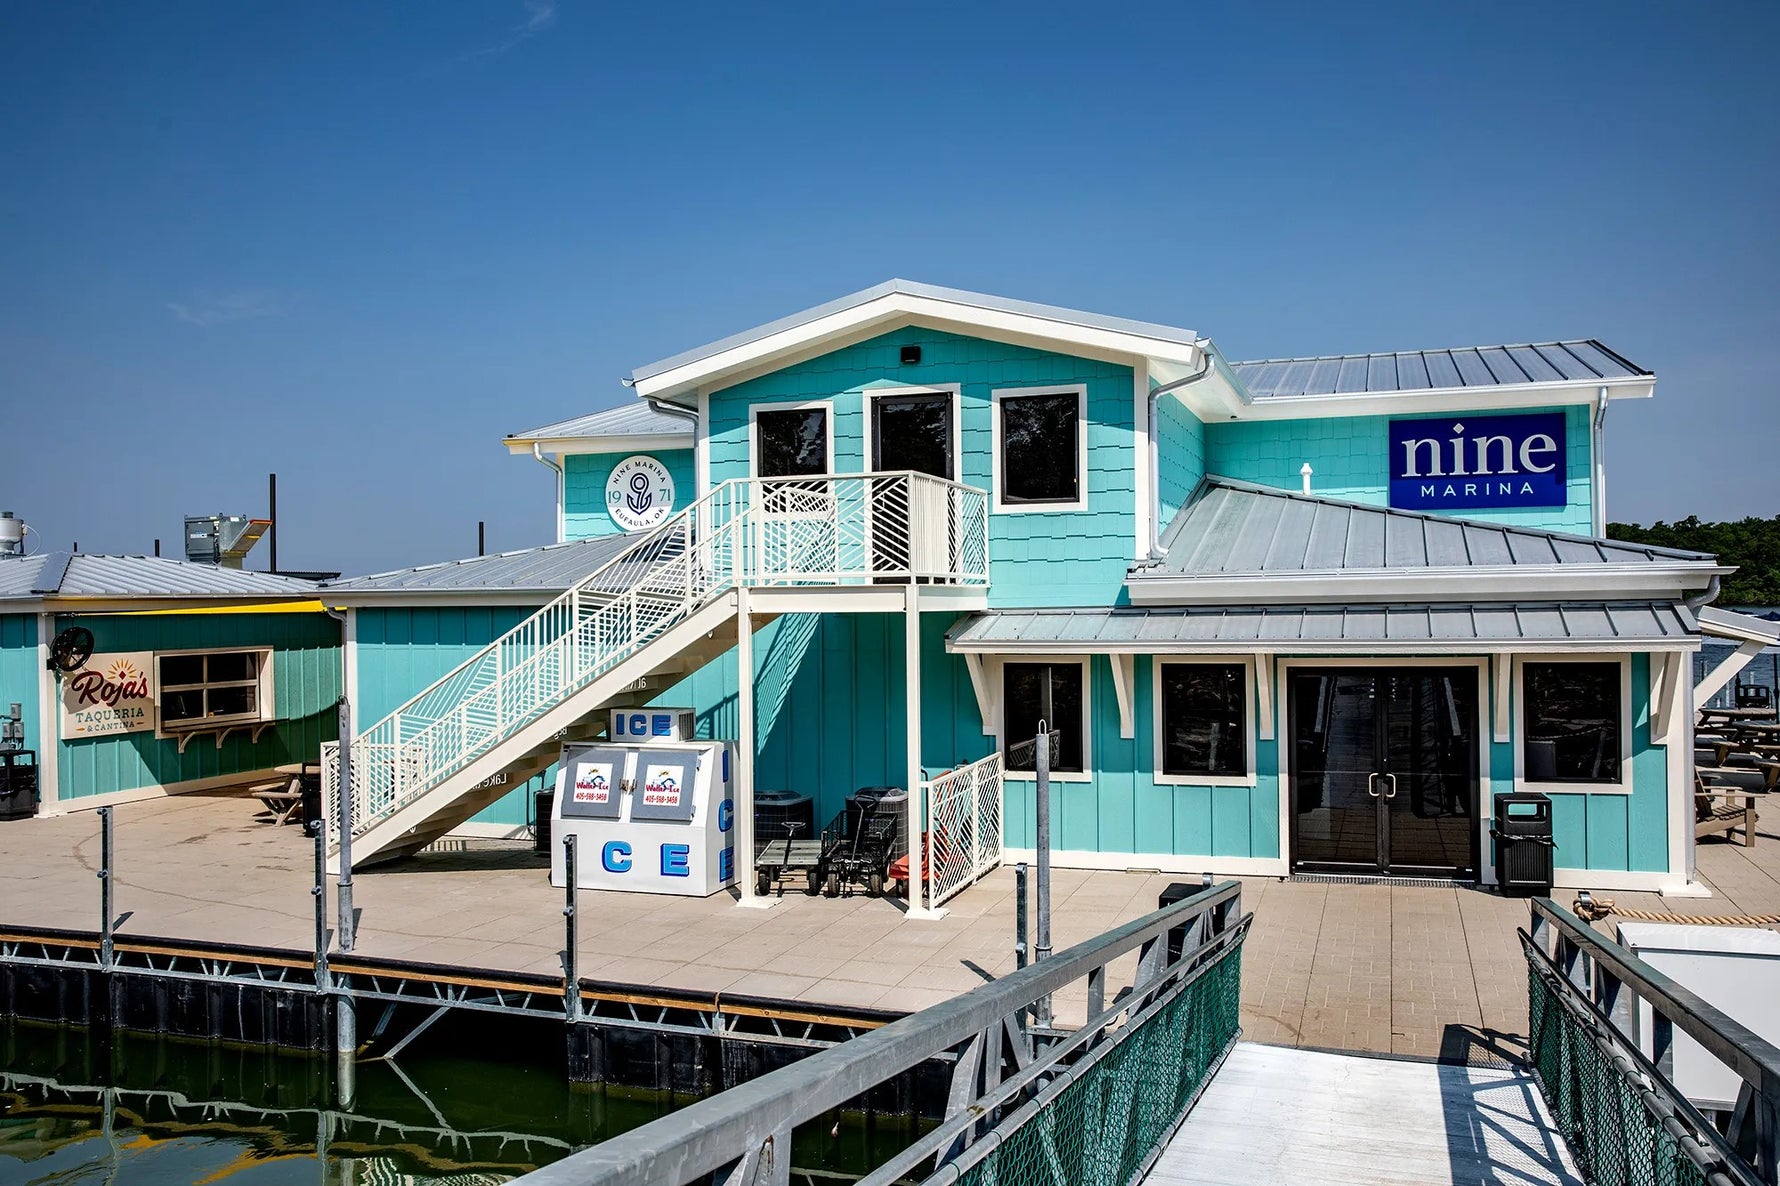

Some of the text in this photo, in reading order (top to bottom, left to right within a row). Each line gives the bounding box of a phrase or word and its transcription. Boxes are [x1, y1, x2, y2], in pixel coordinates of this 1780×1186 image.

[1401, 423, 1557, 477] nine
[613, 461, 666, 484] NINE MARINA
[608, 488, 671, 503] 19 71
[1421, 482, 1534, 497] MARINA
[654, 508, 664, 519] OK
[71, 671, 147, 707] Roja's
[76, 707, 144, 723] TAQUERIA
[94, 721, 135, 731] CANTINA
[616, 713, 671, 736] ICE
[598, 781, 608, 790] Ice
[669, 784, 680, 793] Ice
[718, 749, 734, 883] ICE
